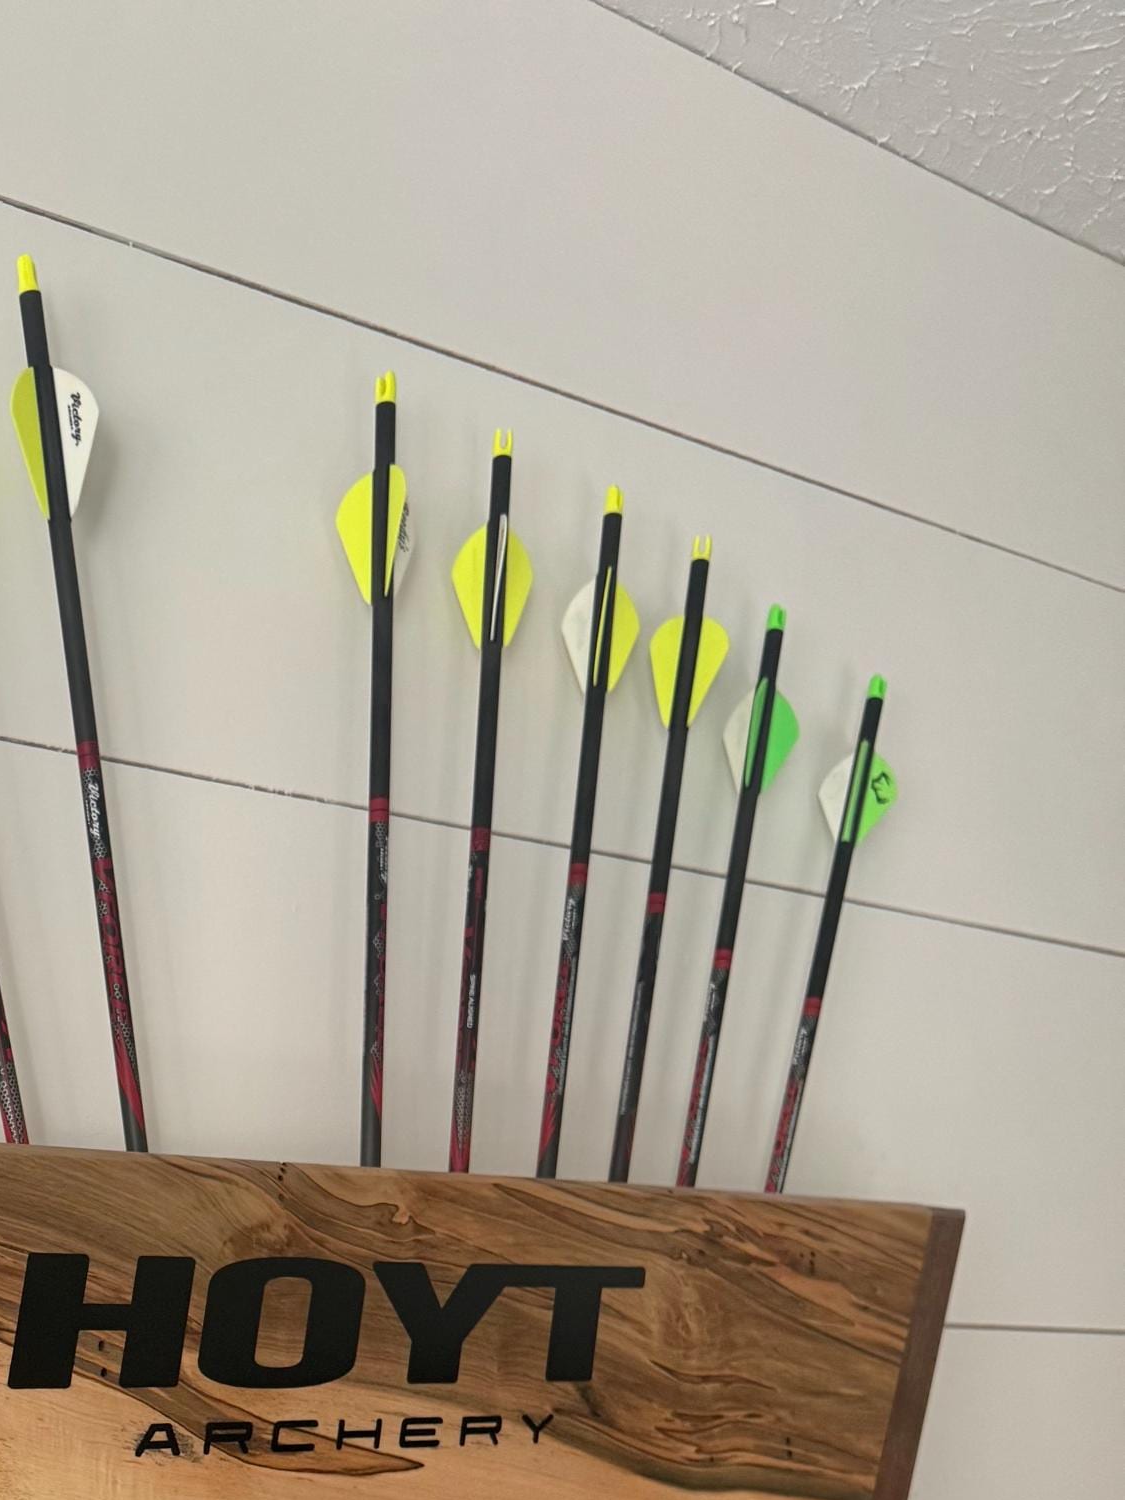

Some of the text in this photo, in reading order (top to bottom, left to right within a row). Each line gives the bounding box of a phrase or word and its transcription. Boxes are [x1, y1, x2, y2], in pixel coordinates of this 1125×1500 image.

[70, 392, 83, 447] Victory
[86, 782, 102, 840] Victory
[8, 1252, 646, 1389] HOYT
[134, 1413, 554, 1458] ARCHERY
